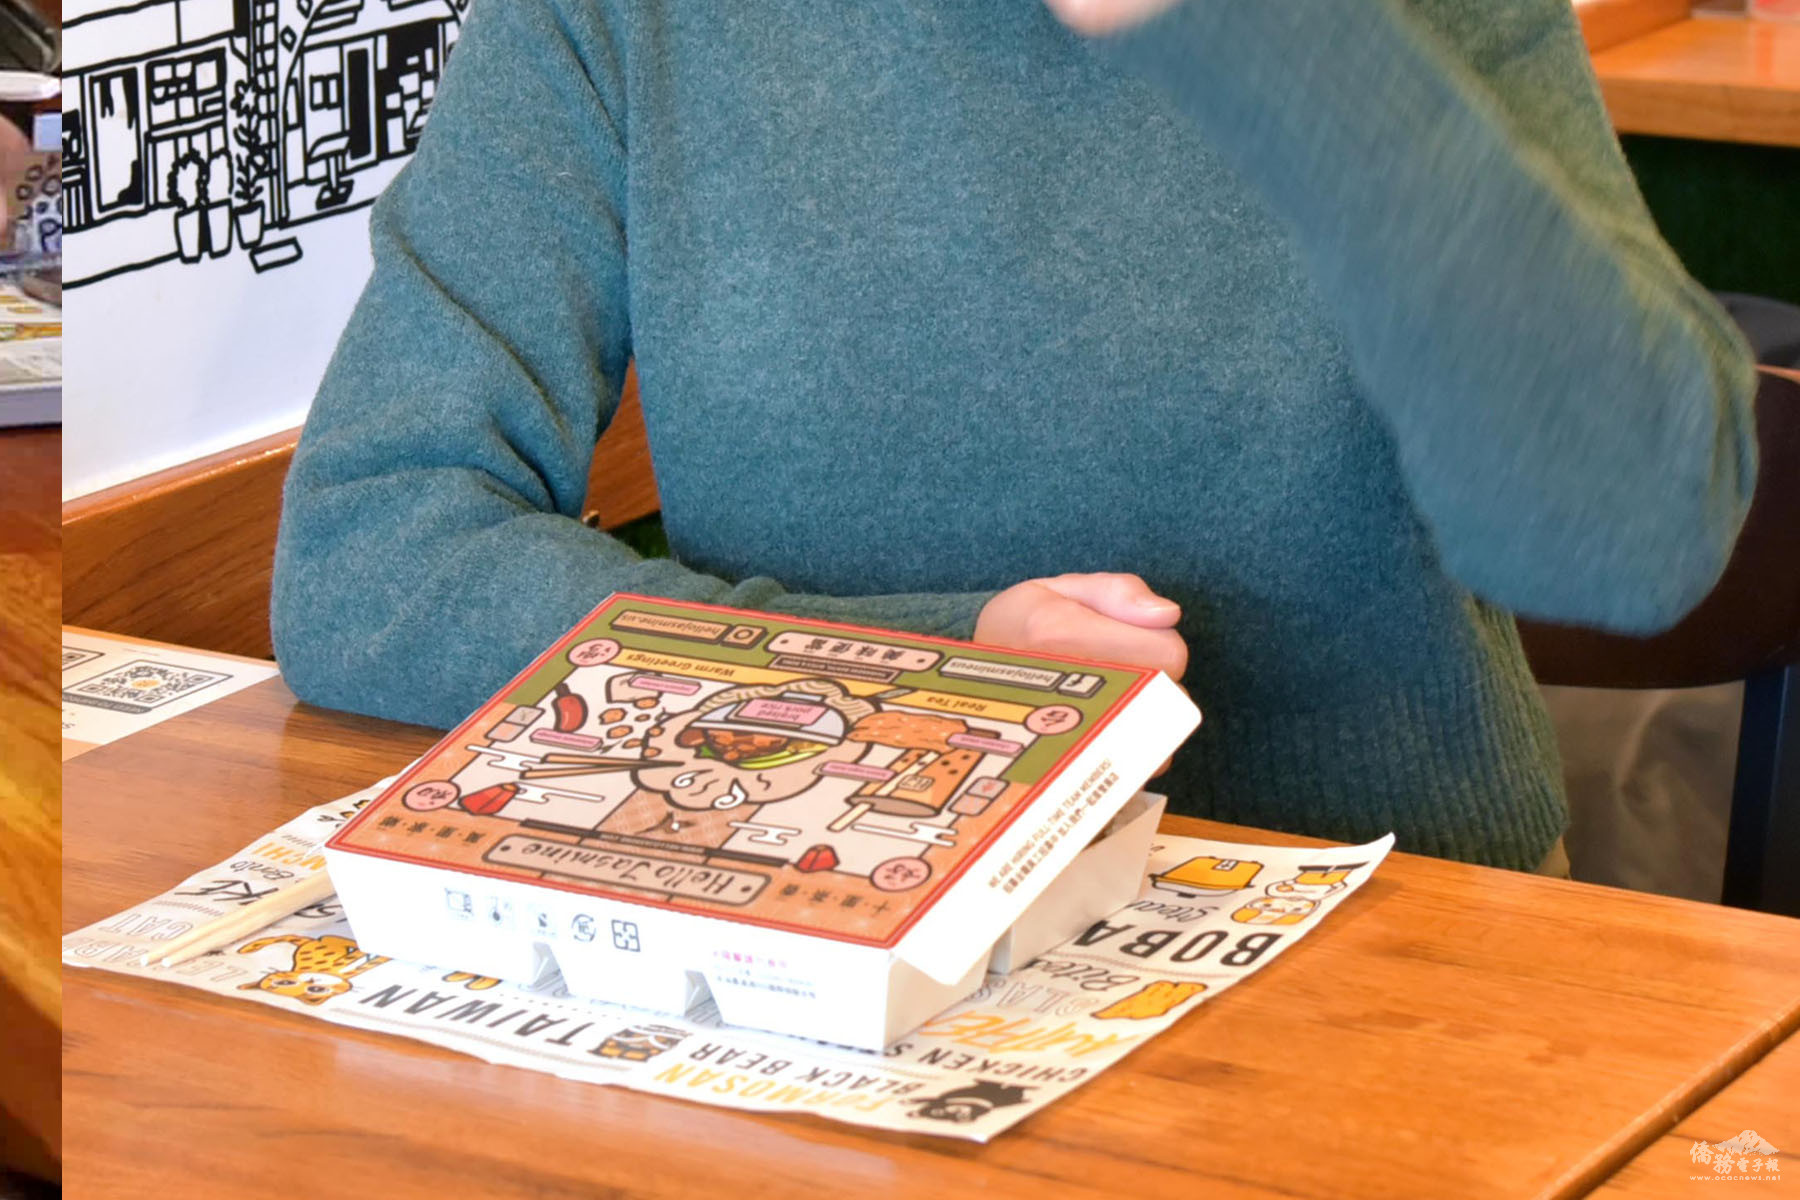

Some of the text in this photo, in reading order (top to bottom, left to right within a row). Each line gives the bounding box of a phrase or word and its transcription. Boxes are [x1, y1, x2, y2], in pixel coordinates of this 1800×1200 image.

[622, 613, 722, 637] hellojasmine.us
[625, 653, 736, 678] Warm Greetings
[950, 661, 1054, 682] hellojasmineus
[756, 709, 800, 722] braised
[761, 701, 814, 714] pork rice
[927, 696, 988, 713] Real Tea
[229, 860, 295, 881] Bento
[520, 841, 738, 897] Hello Jasmine
[100, 912, 194, 941] CAT
[1072, 920, 1284, 967] BOBA
[358, 983, 597, 1048] TAIWAN
[689, 1041, 794, 1077] BEAR
[917, 1045, 1090, 1084] CHICKEN
[654, 1062, 887, 1113] FORMOSAN
[797, 1065, 927, 1096] BLACK
